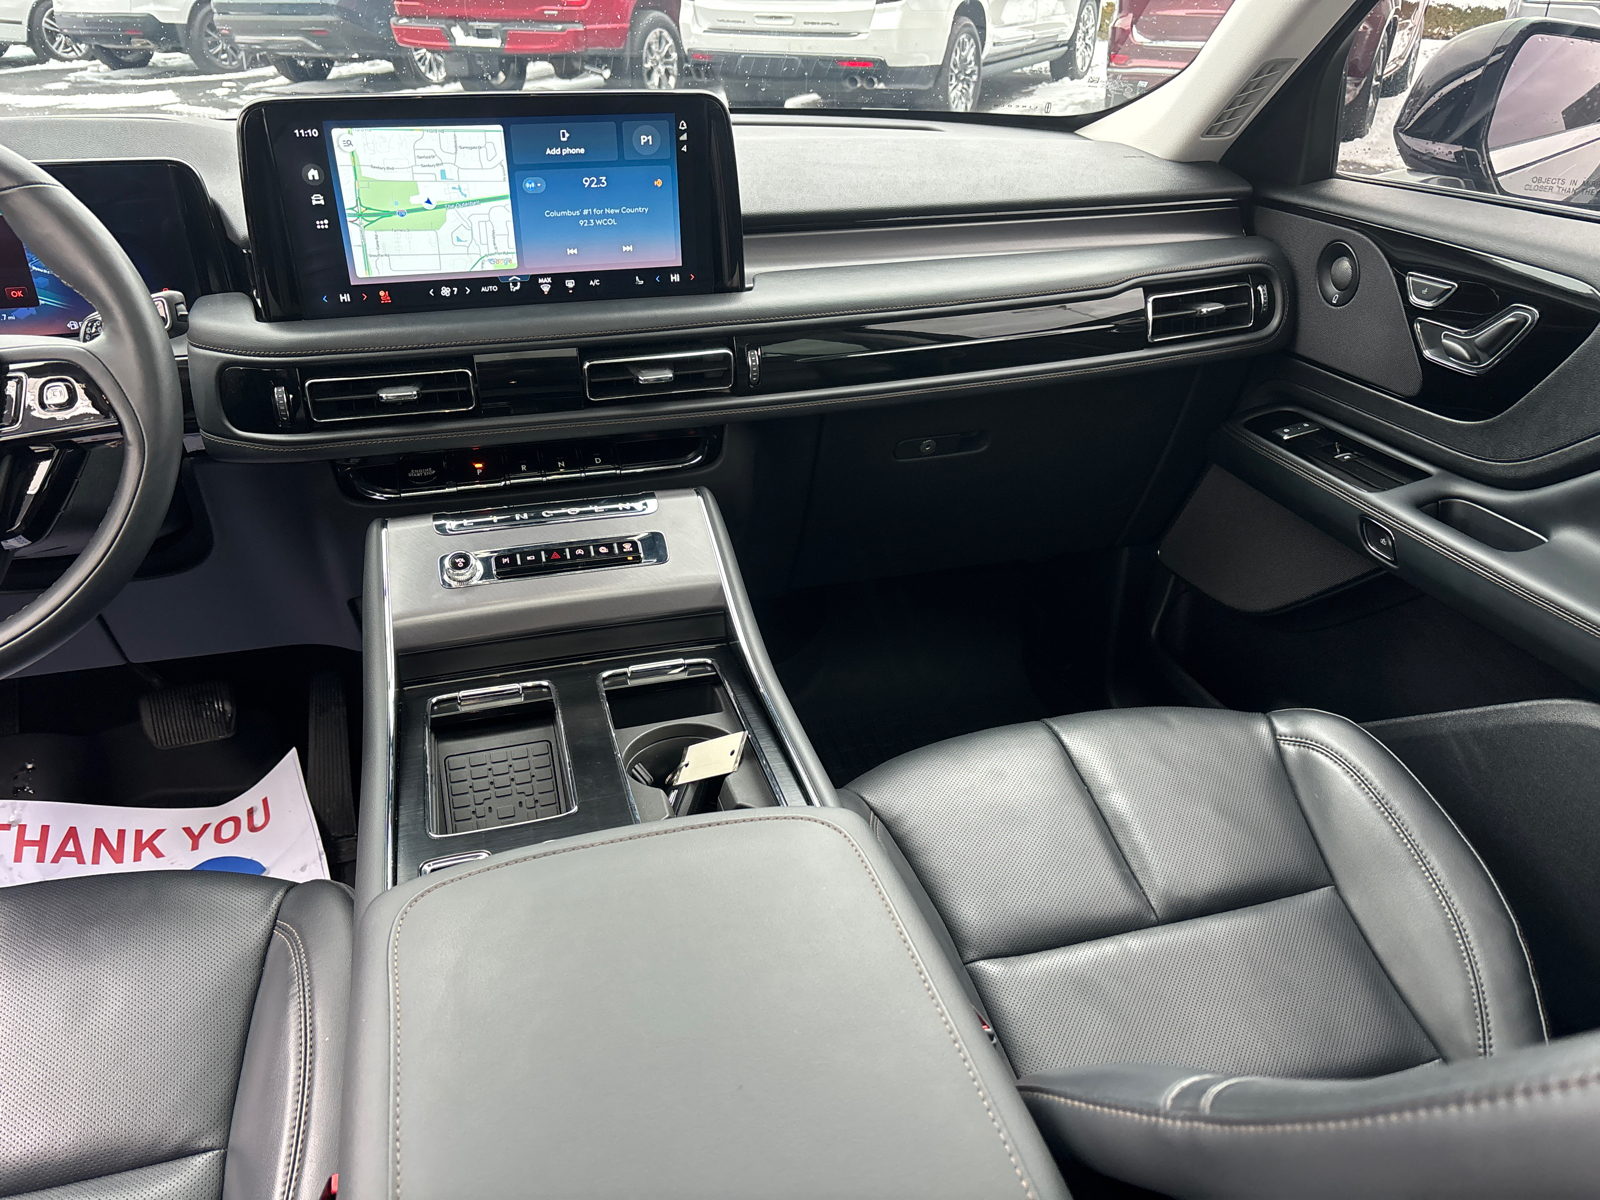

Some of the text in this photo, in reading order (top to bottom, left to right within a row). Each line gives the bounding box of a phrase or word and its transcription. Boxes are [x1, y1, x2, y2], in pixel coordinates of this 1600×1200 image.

[294, 129, 319, 138] 11:10
[640, 135, 653, 145] P1
[545, 147, 585, 156] Add phone
[582, 176, 607, 188] 92.3
[1531, 176, 1566, 185] OBJECTS
[1524, 183, 1554, 193] CLOSER
[1556, 185, 1577, 194] THAN
[544, 206, 649, 218] Columbus' #1 for New Country
[578, 218, 618, 227] 92.3 WCOL
[670, 273, 680, 282] HI
[589, 279, 600, 287] A/C
[10, 290, 24, 298] OK
[339, 293, 351, 303] HI
[463, 502, 631, 527] LINCOLN
[181, 796, 272, 852] YOU
